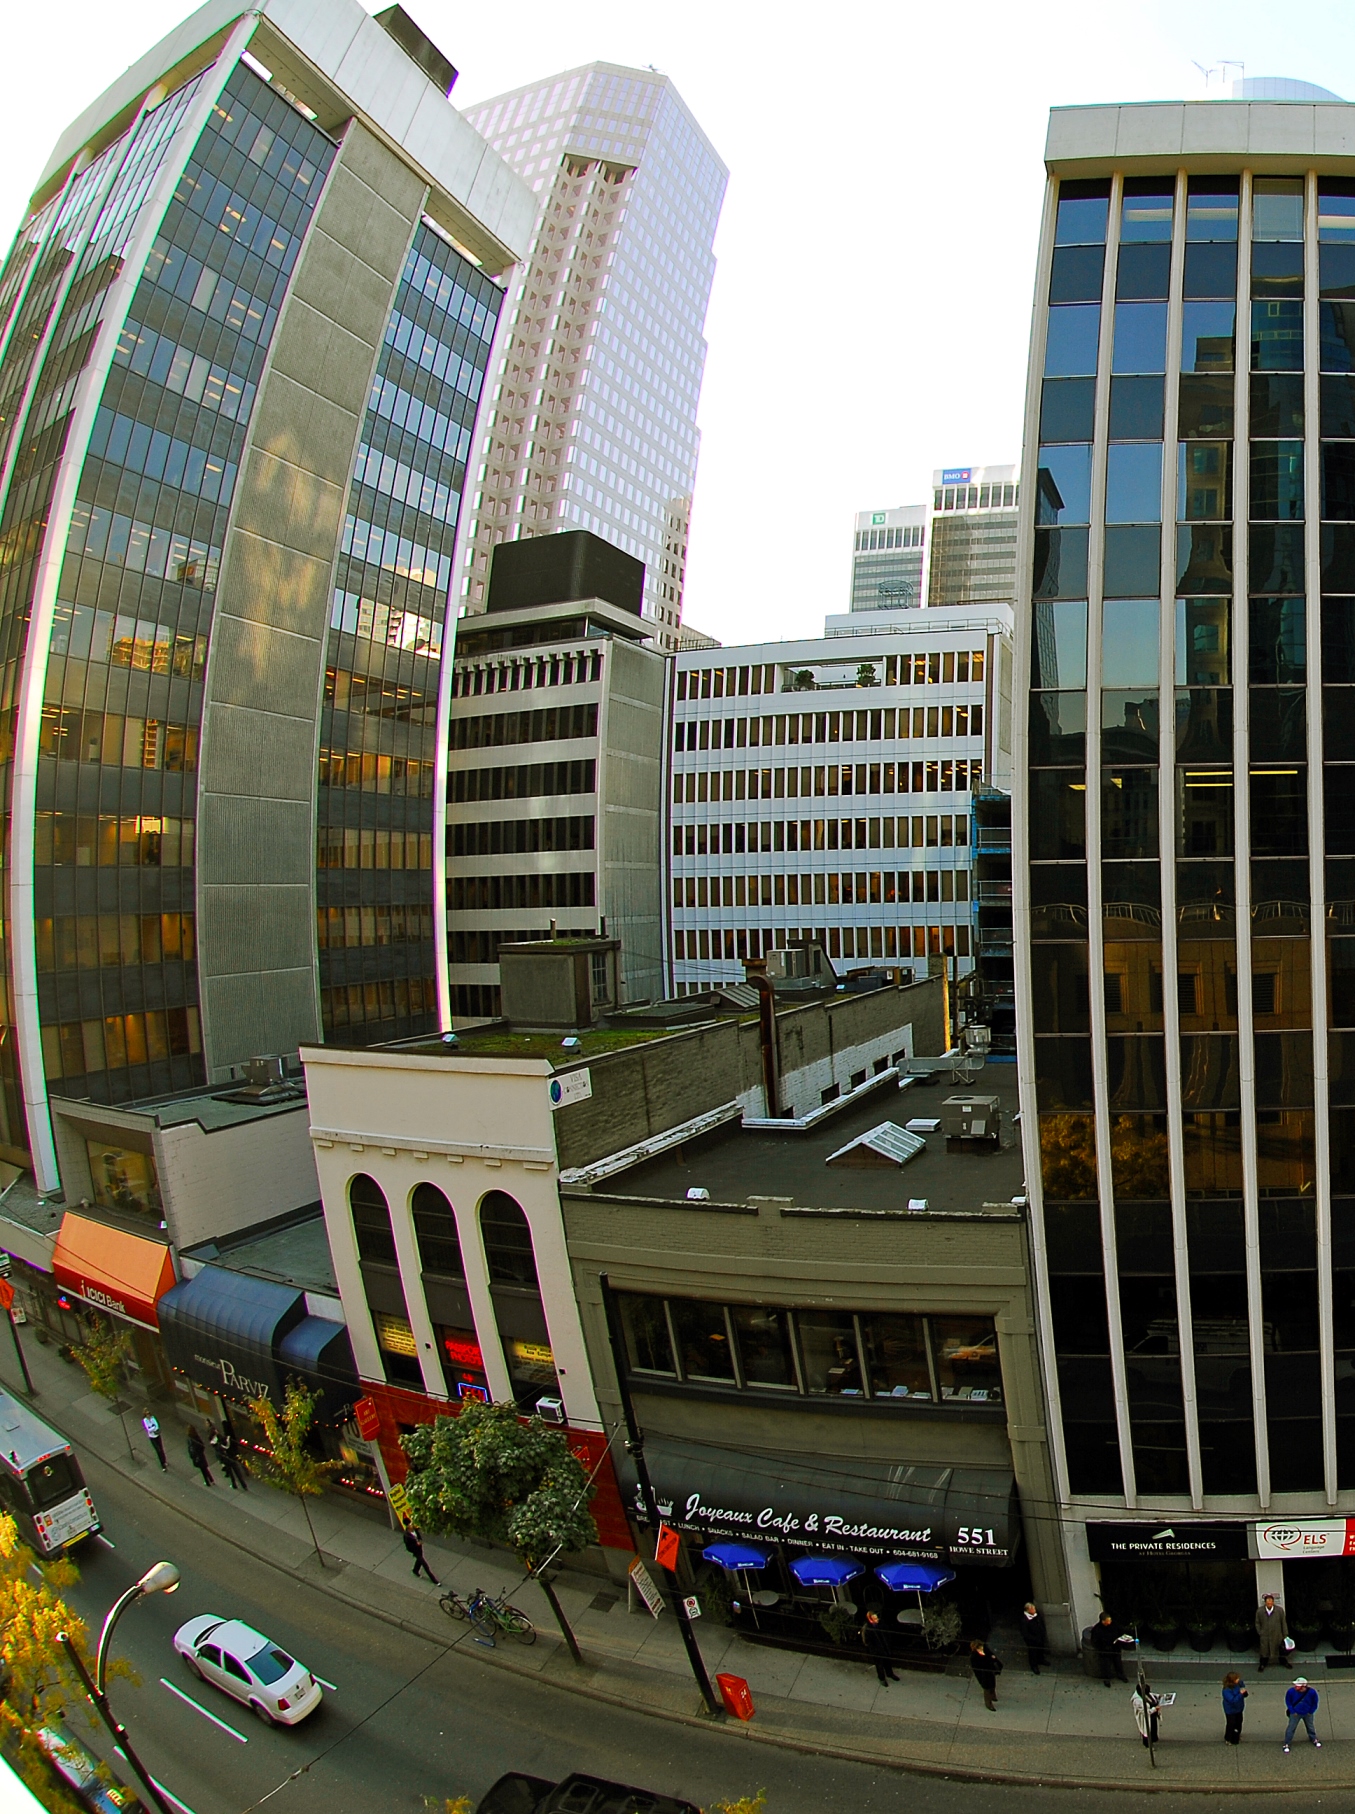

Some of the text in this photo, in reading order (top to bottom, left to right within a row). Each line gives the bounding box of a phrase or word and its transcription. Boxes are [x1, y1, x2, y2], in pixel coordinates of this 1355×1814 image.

[873, 514, 885, 523] TD
[86, 1286, 106, 1304] ICICI
[106, 1296, 126, 1314] Bank
[685, 1493, 932, 1543] Joyeaux Cafe & Restaurant
[677, 1522, 700, 1532] LUNCH
[707, 1527, 734, 1537] SNACKS
[741, 1532, 763, 1541] SALAD
[764, 1535, 779, 1543] BAR
[787, 1538, 814, 1547] DINNER
[822, 1542, 835, 1550] EAT
[849, 1546, 868, 1554] TAKE
[957, 1526, 996, 1546] 551
[1303, 1534, 1327, 1545] ELS
[949, 1546, 1009, 1556] HOWE STREET
[1111, 1542, 1217, 1550] THE PRIVATE RESIDENCES
